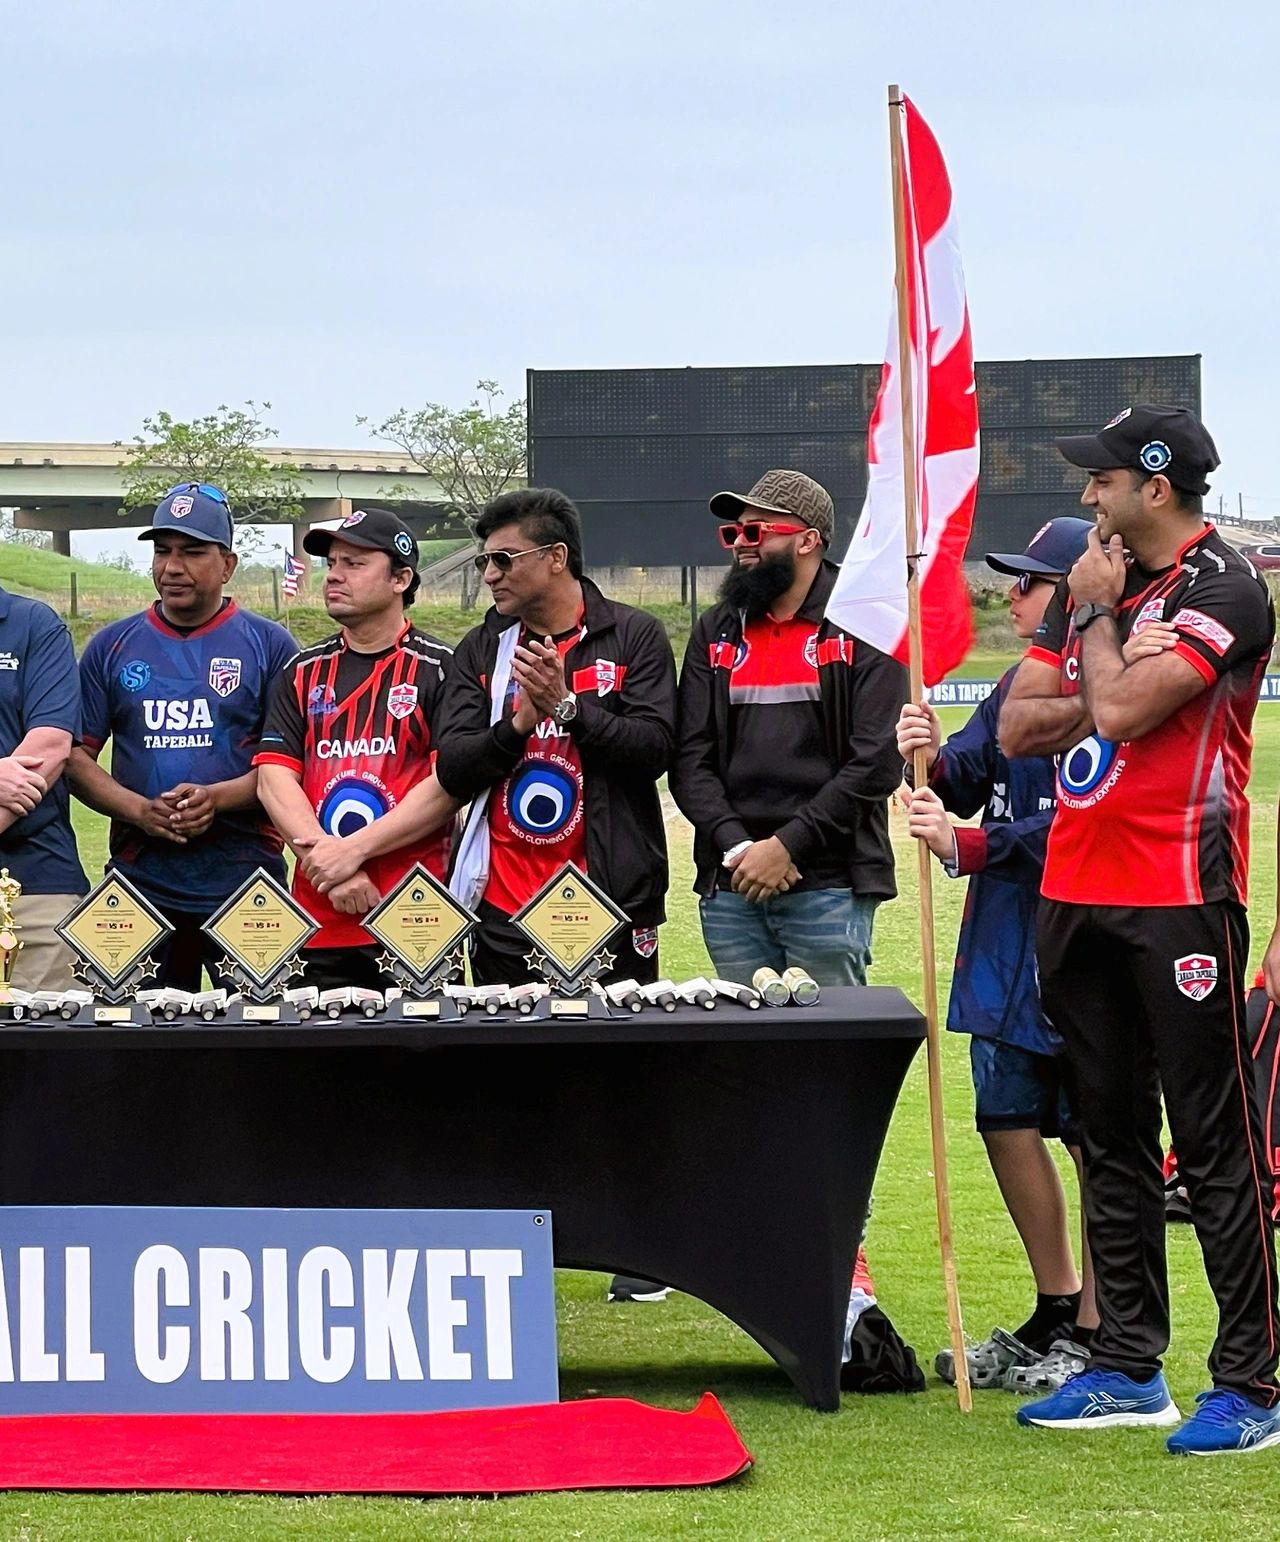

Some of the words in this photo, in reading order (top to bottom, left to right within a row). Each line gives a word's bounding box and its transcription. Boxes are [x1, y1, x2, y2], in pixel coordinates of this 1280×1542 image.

[1178, 612, 1204, 626] BIG
[933, 684, 956, 701] USA
[958, 683, 998, 701] TAPEB
[143, 698, 214, 731] USA
[144, 734, 213, 749] TAPEBALL
[317, 736, 396, 759] CANADA
[550, 754, 576, 773] GROUP
[361, 771, 387, 793] GROUP
[1095, 759, 1126, 800] EXPORTS
[525, 834, 565, 845] CLOTHING
[133, 1244, 523, 1383] CRICKET
